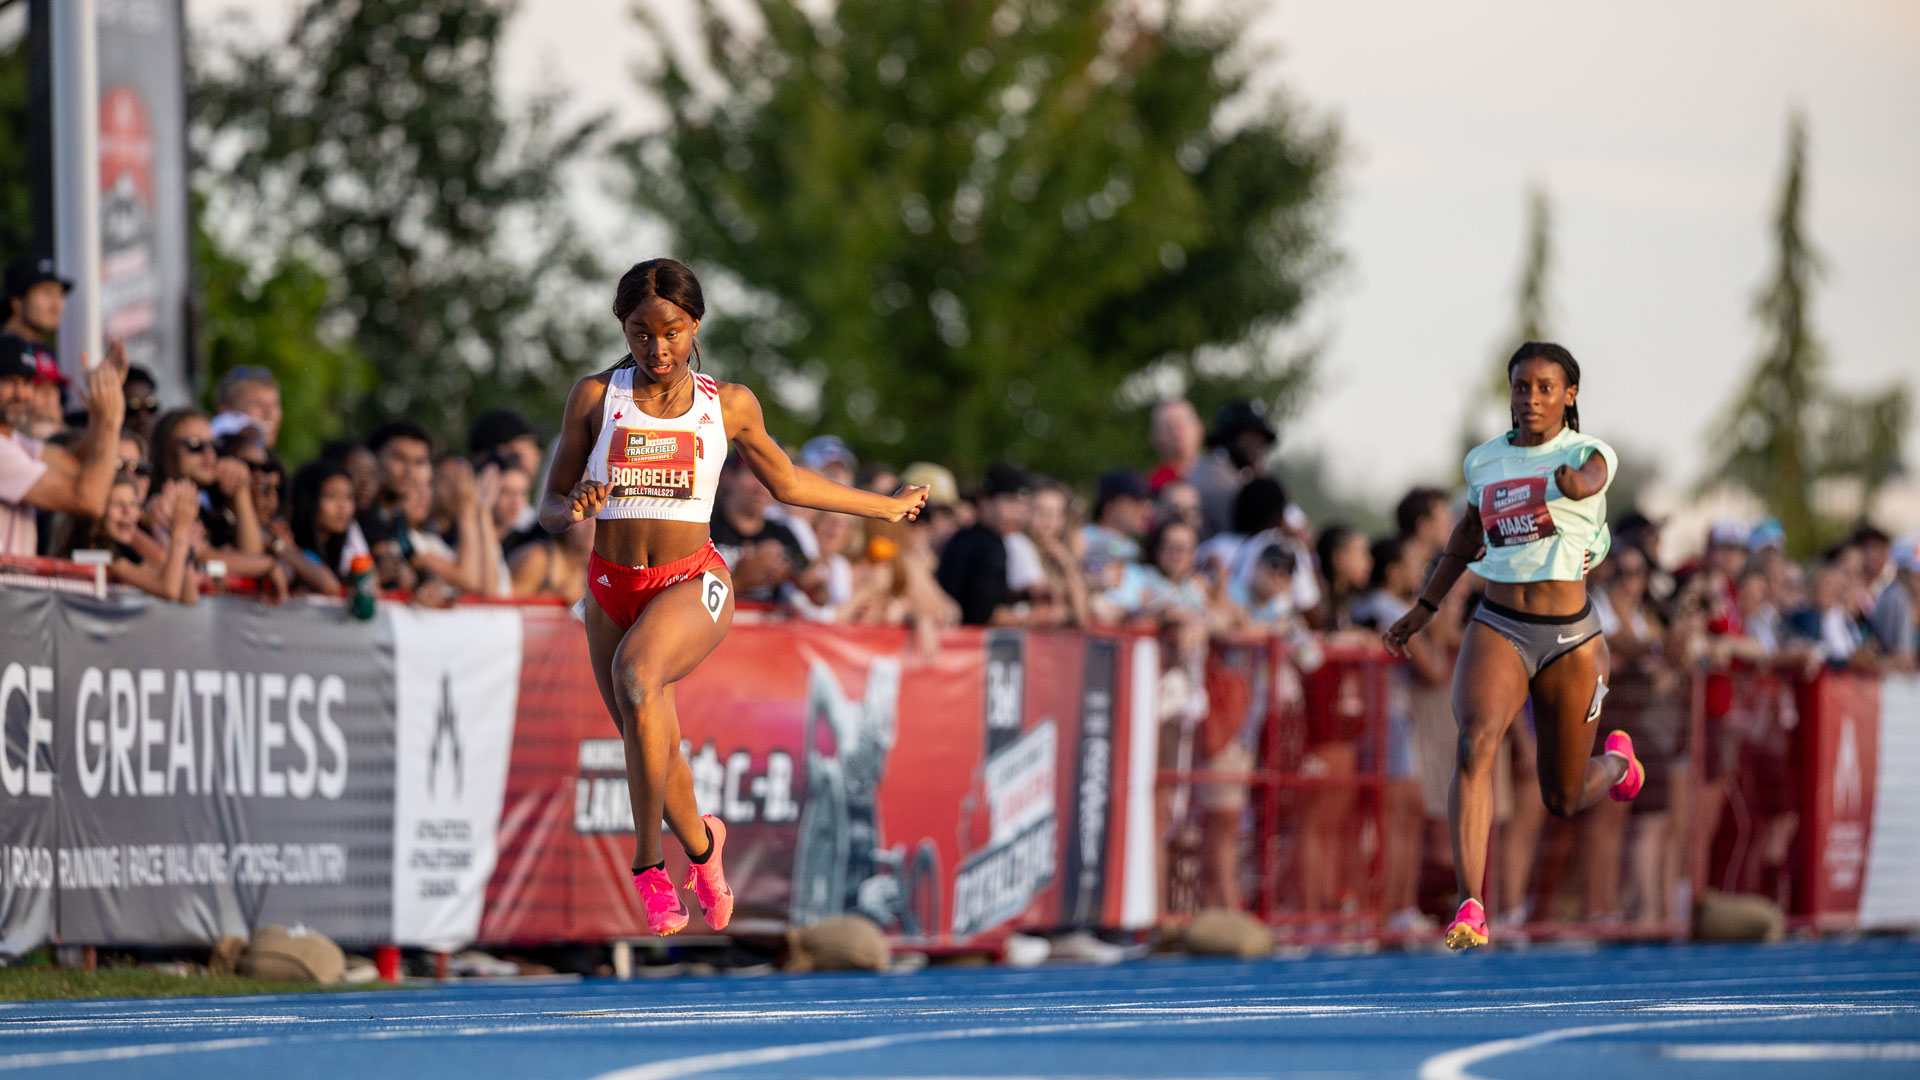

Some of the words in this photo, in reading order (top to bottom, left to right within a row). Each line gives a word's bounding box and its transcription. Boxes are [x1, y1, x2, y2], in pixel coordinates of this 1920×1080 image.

[630, 436, 644, 445] Bell
[626, 444, 676, 456] TRACK&FIELD
[631, 454, 670, 462] CHAMPIONSHIPS
[611, 467, 690, 488] BORGELLA
[624, 487, 674, 497] #BELLTRIALS23
[1496, 514, 1538, 536] HAASE
[708, 580, 724, 612] 6
[0, 661, 54, 797] CE
[75, 666, 349, 799] GREATNESS
